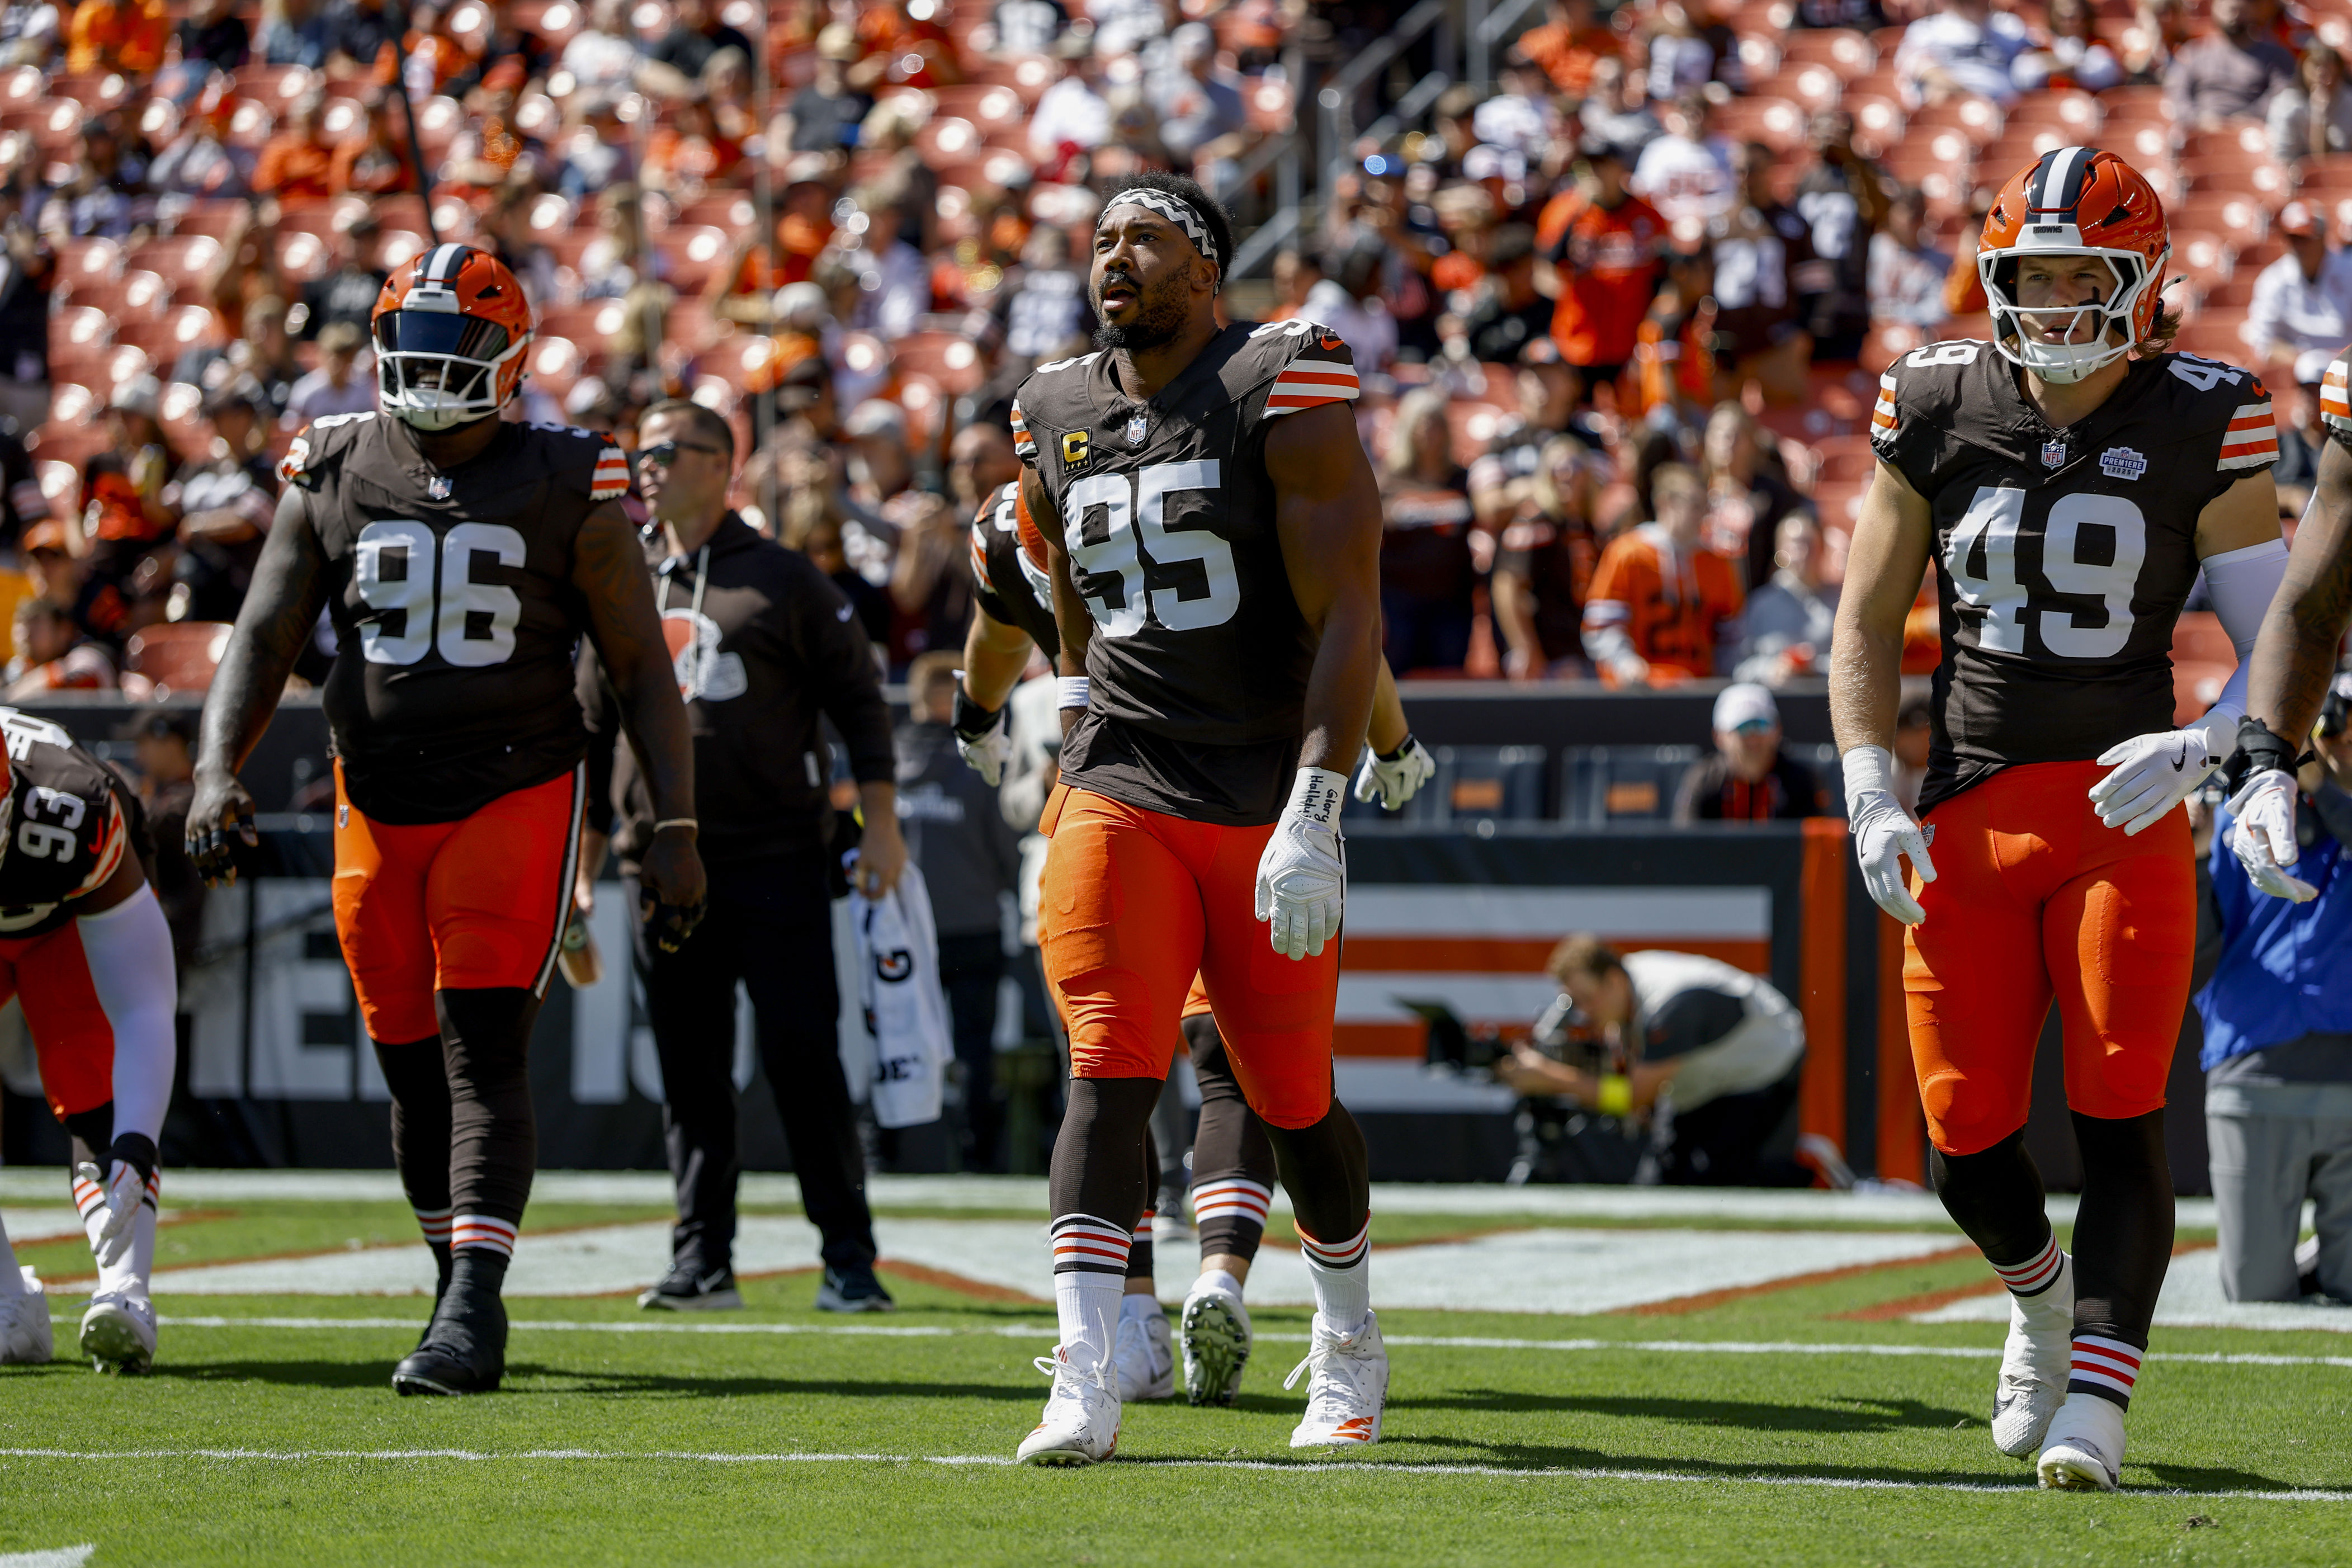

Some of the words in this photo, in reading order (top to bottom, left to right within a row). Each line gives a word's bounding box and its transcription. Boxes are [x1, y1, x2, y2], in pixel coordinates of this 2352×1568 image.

[2033, 225, 2062, 234] BROWNS
[1906, 338, 1990, 368] 9
[1062, 431, 1088, 463] C
[1130, 429, 1142, 440] NFL
[2045, 452, 2061, 465] NFL
[1064, 458, 1240, 638] 95
[1945, 486, 2147, 658] 49
[356, 519, 527, 667] 96
[1314, 788, 1338, 823] Glory
[18, 786, 86, 863] 93
